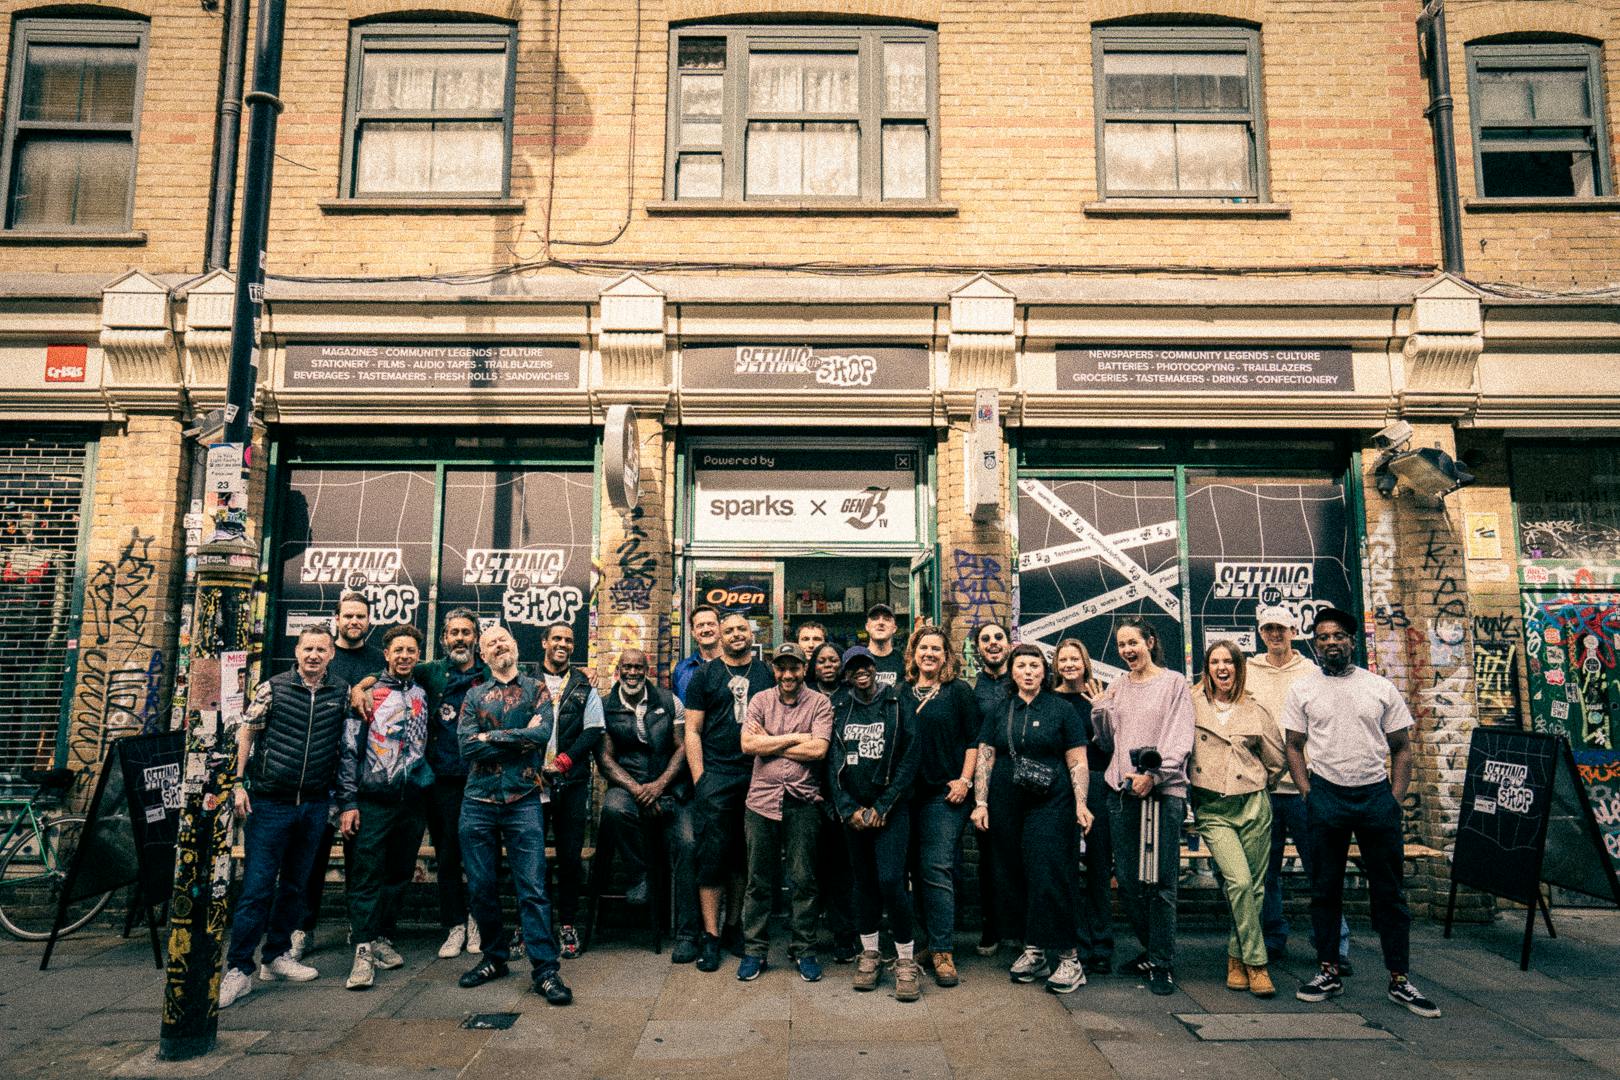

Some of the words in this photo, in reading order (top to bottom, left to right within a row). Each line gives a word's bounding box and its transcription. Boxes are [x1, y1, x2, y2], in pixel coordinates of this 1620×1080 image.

[321, 348, 378, 357] MAGAZINES
[385, 348, 447, 357] COMMUNITY
[448, 348, 492, 357] LEGENDS
[499, 348, 543, 357] CULTURE
[1088, 350, 1154, 359] NEWSPAPERS
[1160, 351, 1221, 360] COMMUNITY
[1223, 351, 1269, 360] LEGENDS
[1276, 351, 1321, 360] CULTURE
[311, 359, 370, 368] STATIONERY
[377, 360, 406, 369] FILMS
[413, 360, 444, 369] AUDIO
[447, 360, 476, 369] TAPES
[484, 360, 553, 369] TRAILBLAZERS
[736, 347, 812, 373] SETTING
[818, 357, 875, 384] SHOP
[1098, 362, 1149, 371] BATTERIES
[1156, 363, 1235, 371] PHOTOCOPYING
[1242, 363, 1313, 372] TRAILBLAZERS
[293, 371, 350, 380] BEVERAGES
[358, 371, 426, 380] TASTEMAKERS
[434, 372, 465, 380] FRESH
[467, 372, 498, 381] ROLLS
[504, 372, 570, 381] SANDWICHES
[1072, 373, 1128, 382] GROCERIES
[1135, 374, 1204, 383] TASTEMAKERS
[1212, 375, 1248, 384] DRINKS
[1256, 375, 1338, 384] CONFECTIONERY
[704, 455, 757, 465] Powered
[760, 456, 775, 467] by
[217, 481, 229, 489] 23
[711, 494, 794, 520] sparks
[303, 549, 401, 583] SETTING
[463, 550, 563, 584] SETTING
[349, 577, 367, 587] UP
[511, 578, 528, 588] UP
[1215, 563, 1312, 598] SETTING
[706, 588, 765, 606] Open
[1263, 591, 1280, 602] UP
[506, 588, 580, 622] SHOP
[1022, 621, 1056, 636] Community
[1056, 611, 1080, 623] legends
[860, 742, 884, 756] SHO
[1499, 788, 1532, 812] SHOP
